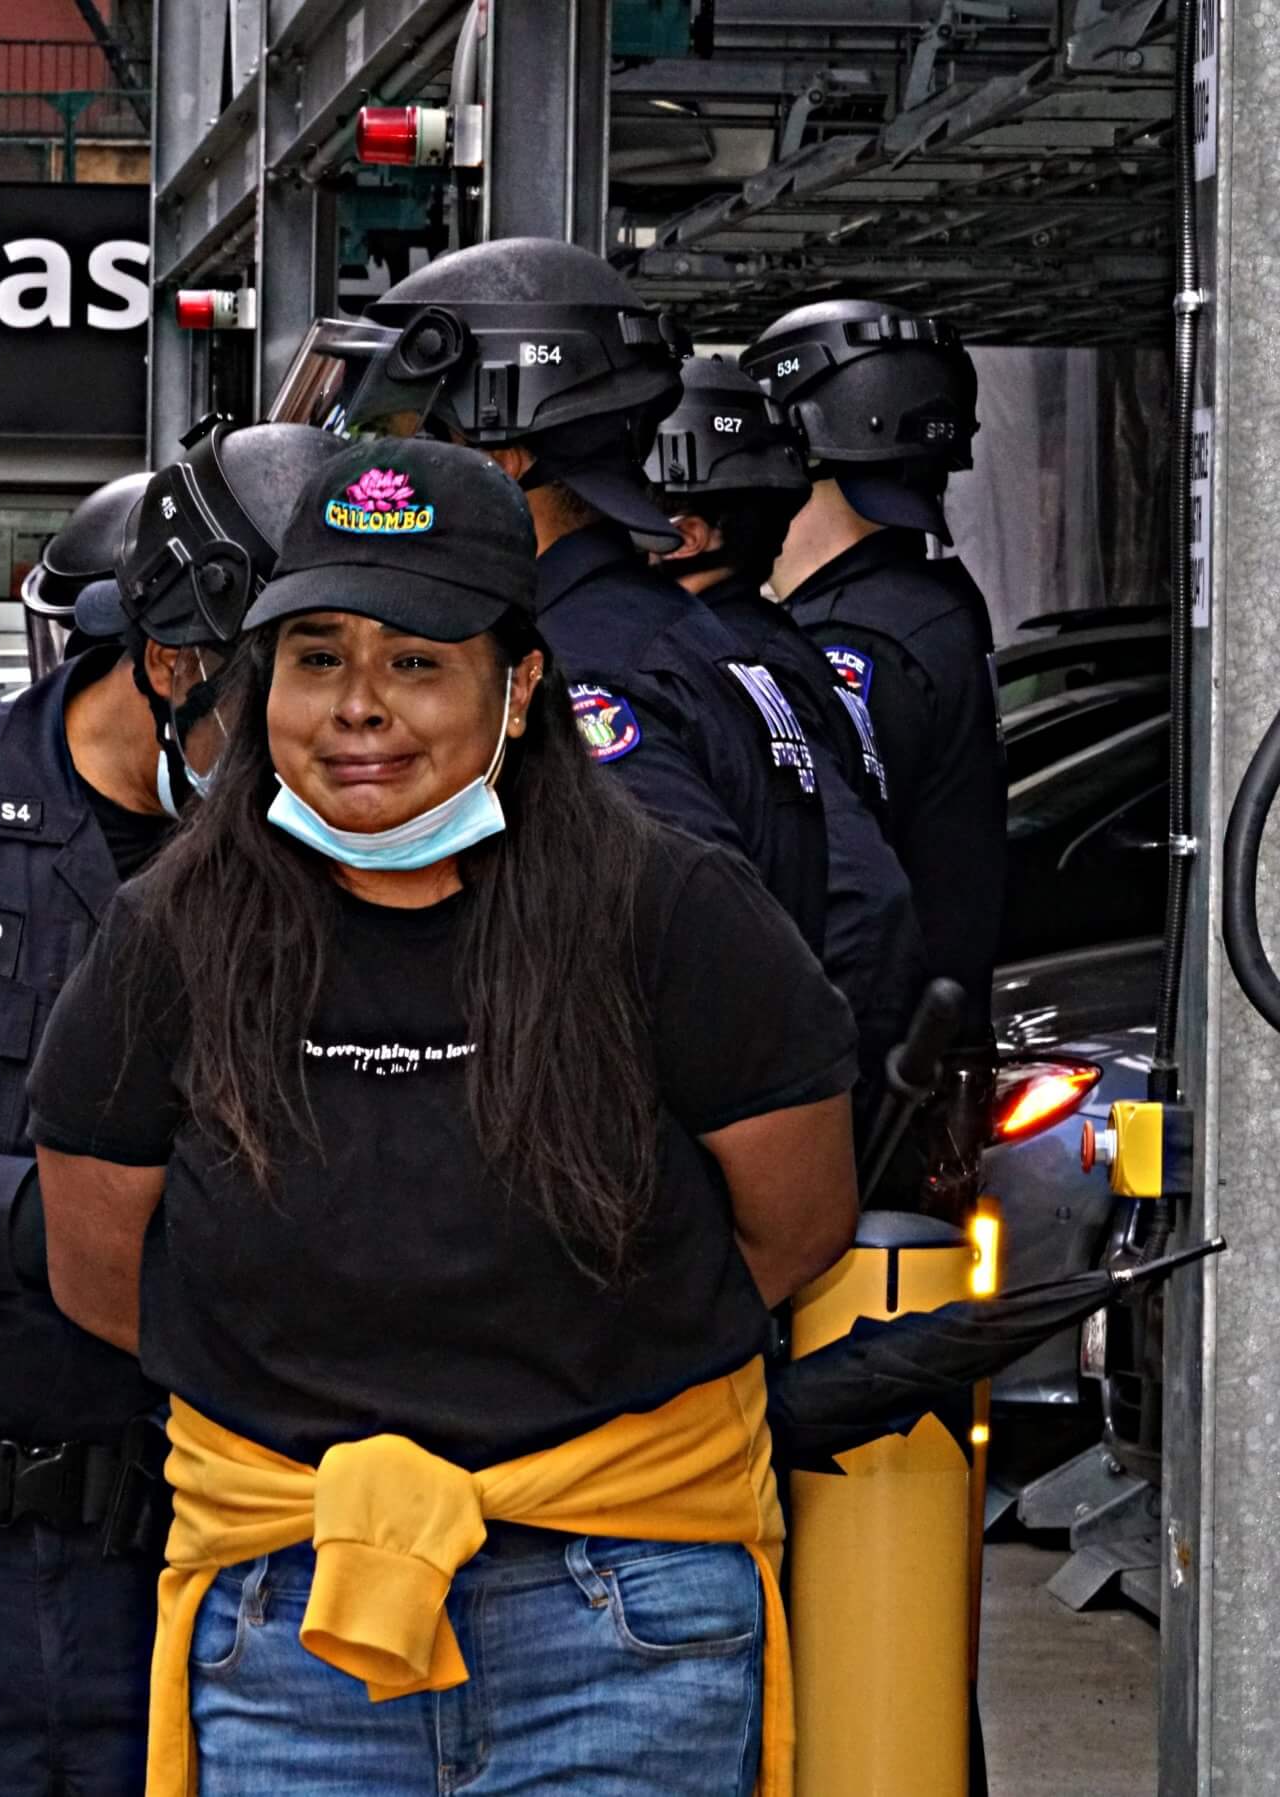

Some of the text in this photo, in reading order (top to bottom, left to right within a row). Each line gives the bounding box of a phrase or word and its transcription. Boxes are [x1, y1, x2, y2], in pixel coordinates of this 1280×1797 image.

[525, 344, 562, 365] 654
[777, 357, 800, 378] 534
[713, 416, 742, 433] 627
[329, 505, 430, 530] CHILOMBO
[825, 650, 866, 674] OLICE
[1, 802, 32, 822] S4
[424, 1046, 443, 1060] in
